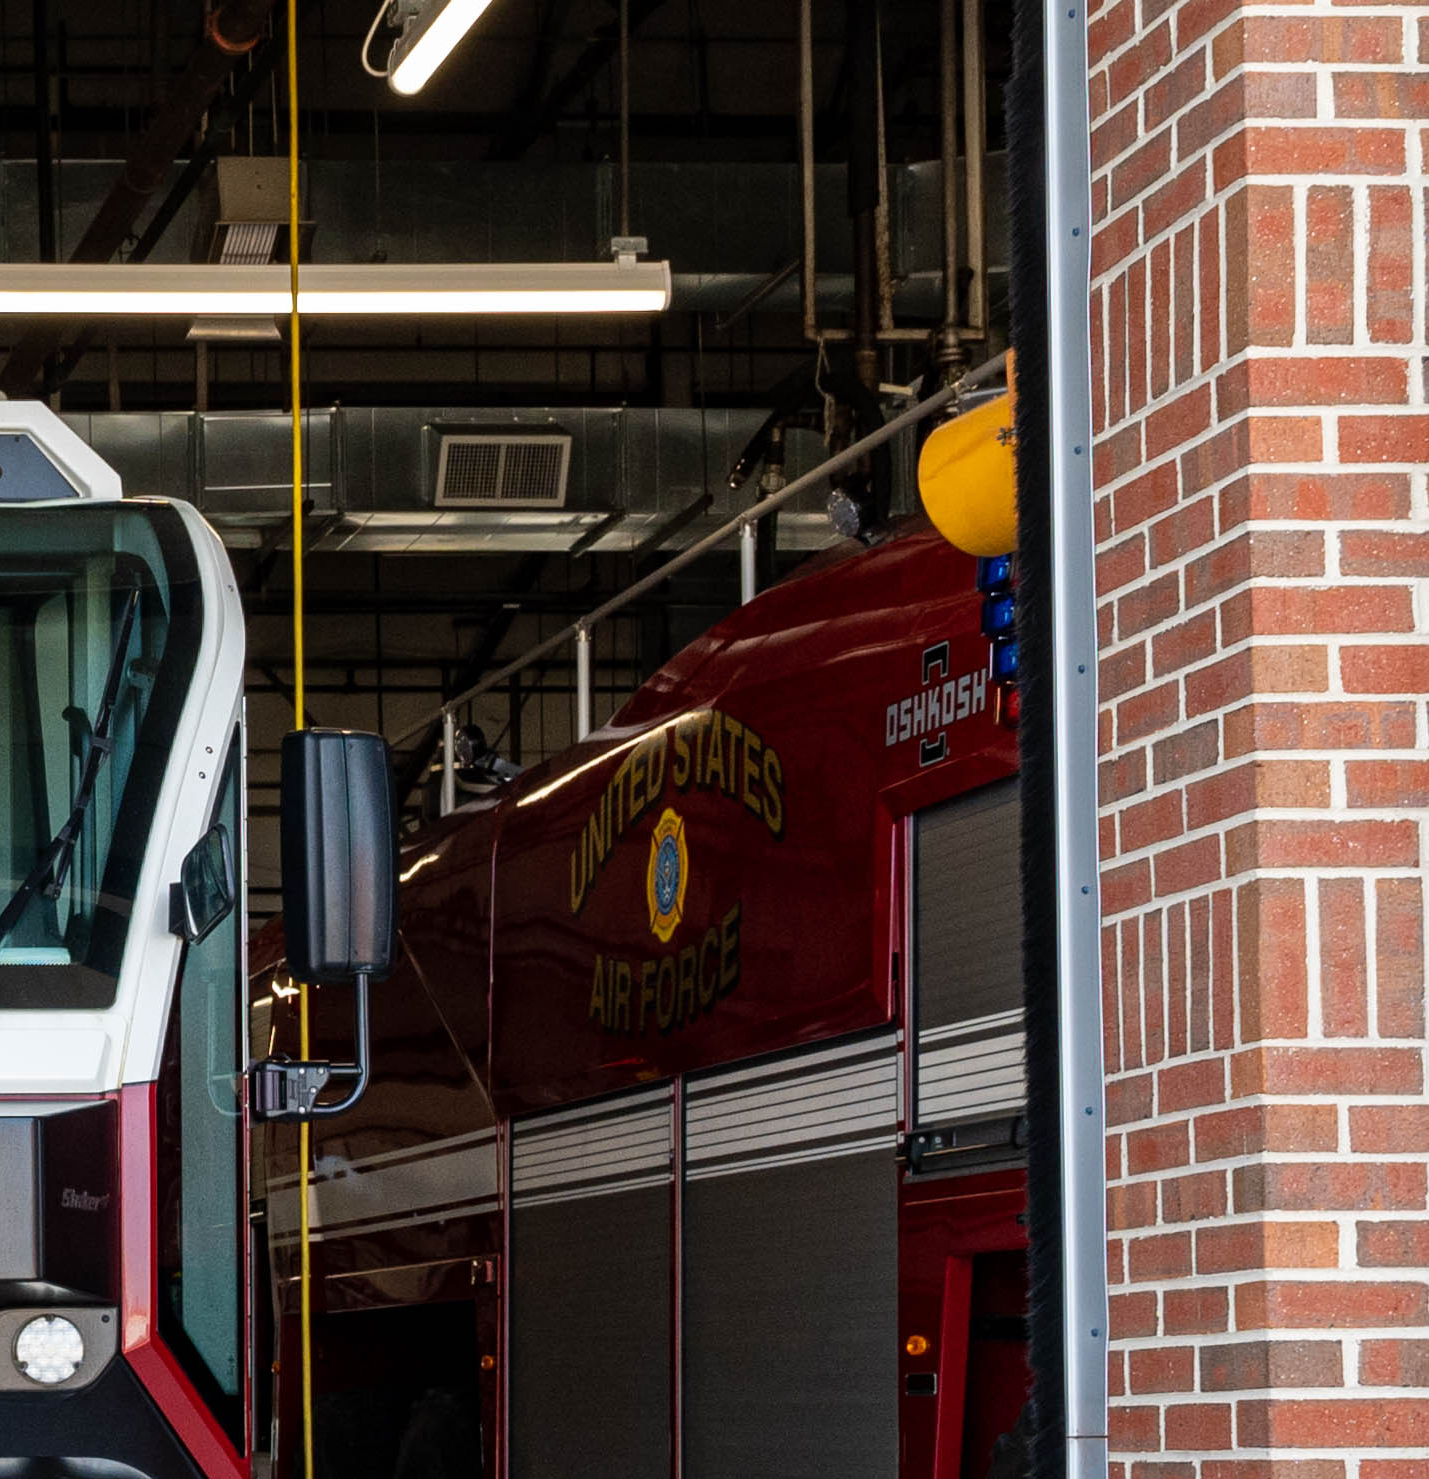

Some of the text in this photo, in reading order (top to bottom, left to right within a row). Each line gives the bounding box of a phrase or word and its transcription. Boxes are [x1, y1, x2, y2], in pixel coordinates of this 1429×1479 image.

[886, 668, 987, 747] OSHKOSH
[571, 709, 783, 913] UNITED STATES
[590, 901, 740, 1031] AIR FORCE
